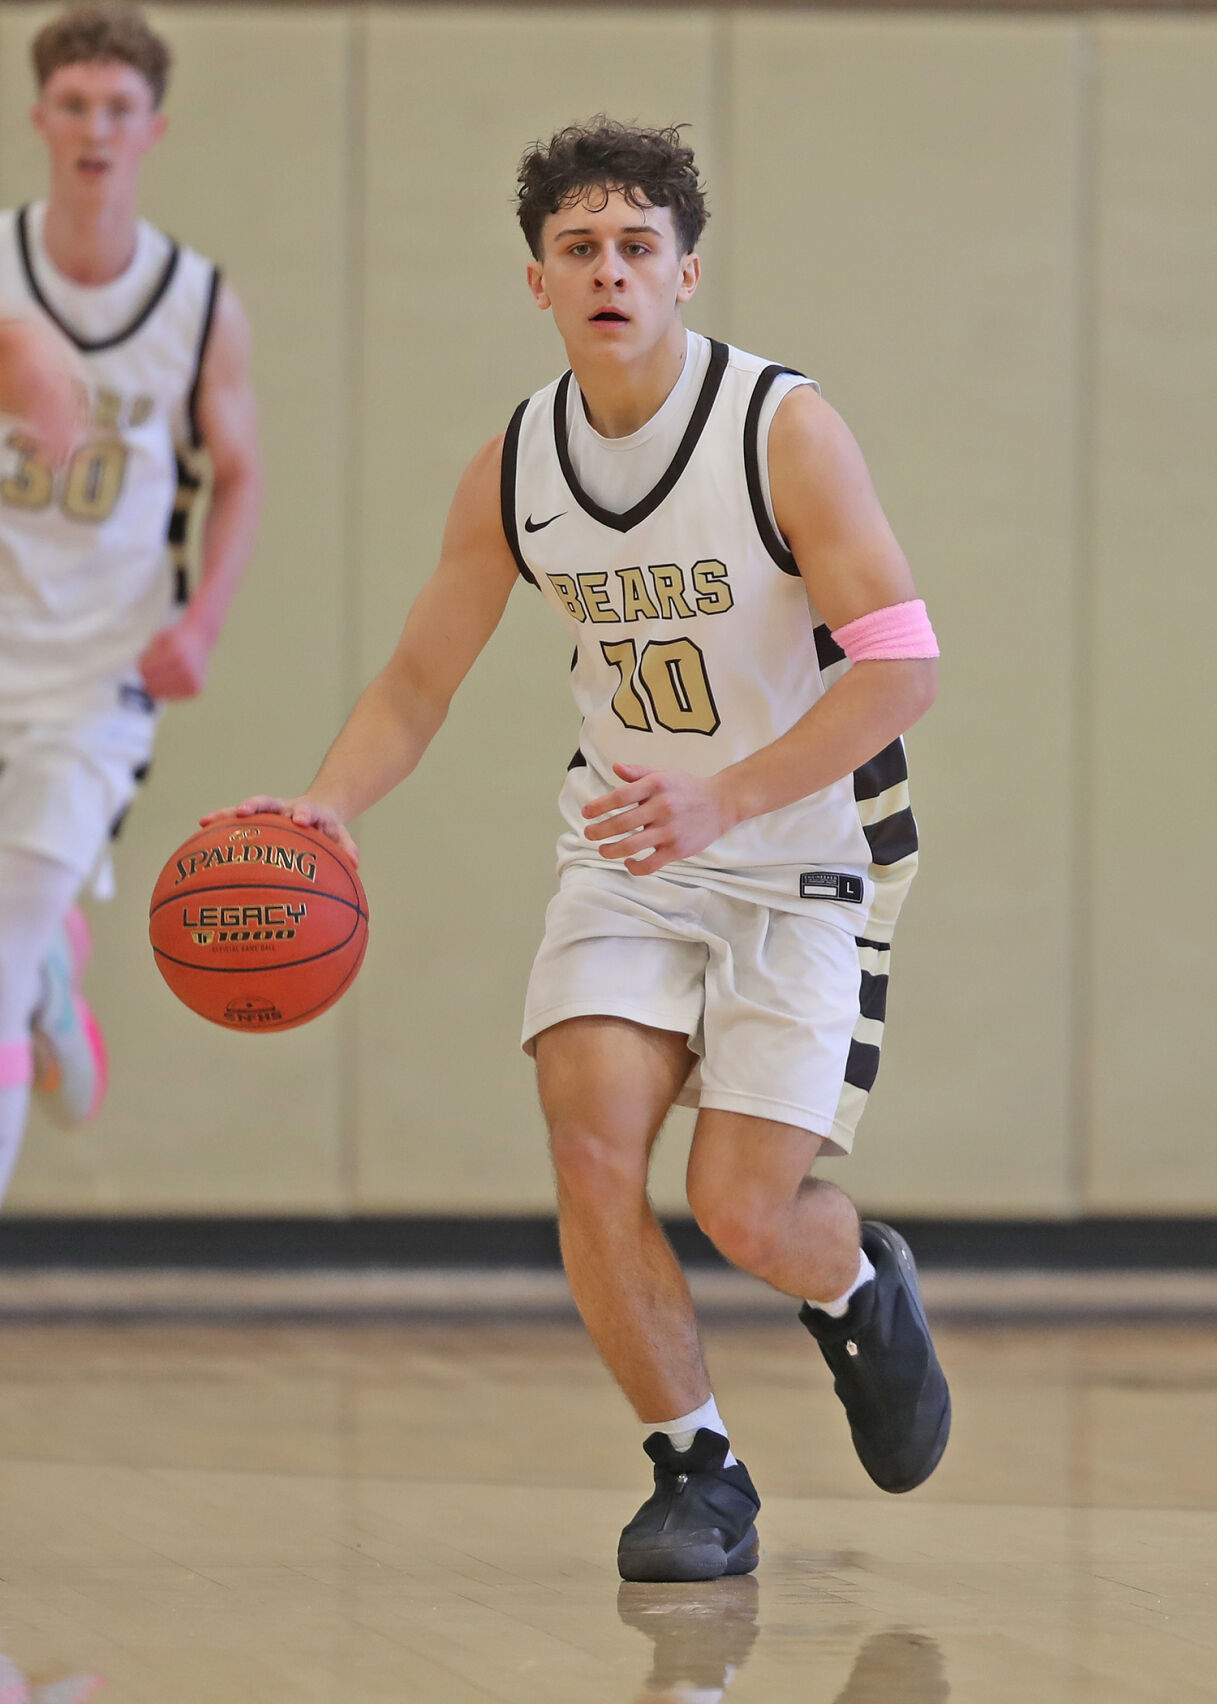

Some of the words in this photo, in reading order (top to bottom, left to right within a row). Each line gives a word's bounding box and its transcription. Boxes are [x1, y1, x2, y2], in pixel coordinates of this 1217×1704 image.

[1, 430, 127, 522] 30
[546, 559, 734, 623] BEARS
[600, 637, 721, 737] 10
[175, 845, 317, 883] SPALDING
[846, 881, 854, 894] L
[182, 904, 307, 929] LEGACY
[218, 929, 296, 943] 1000
